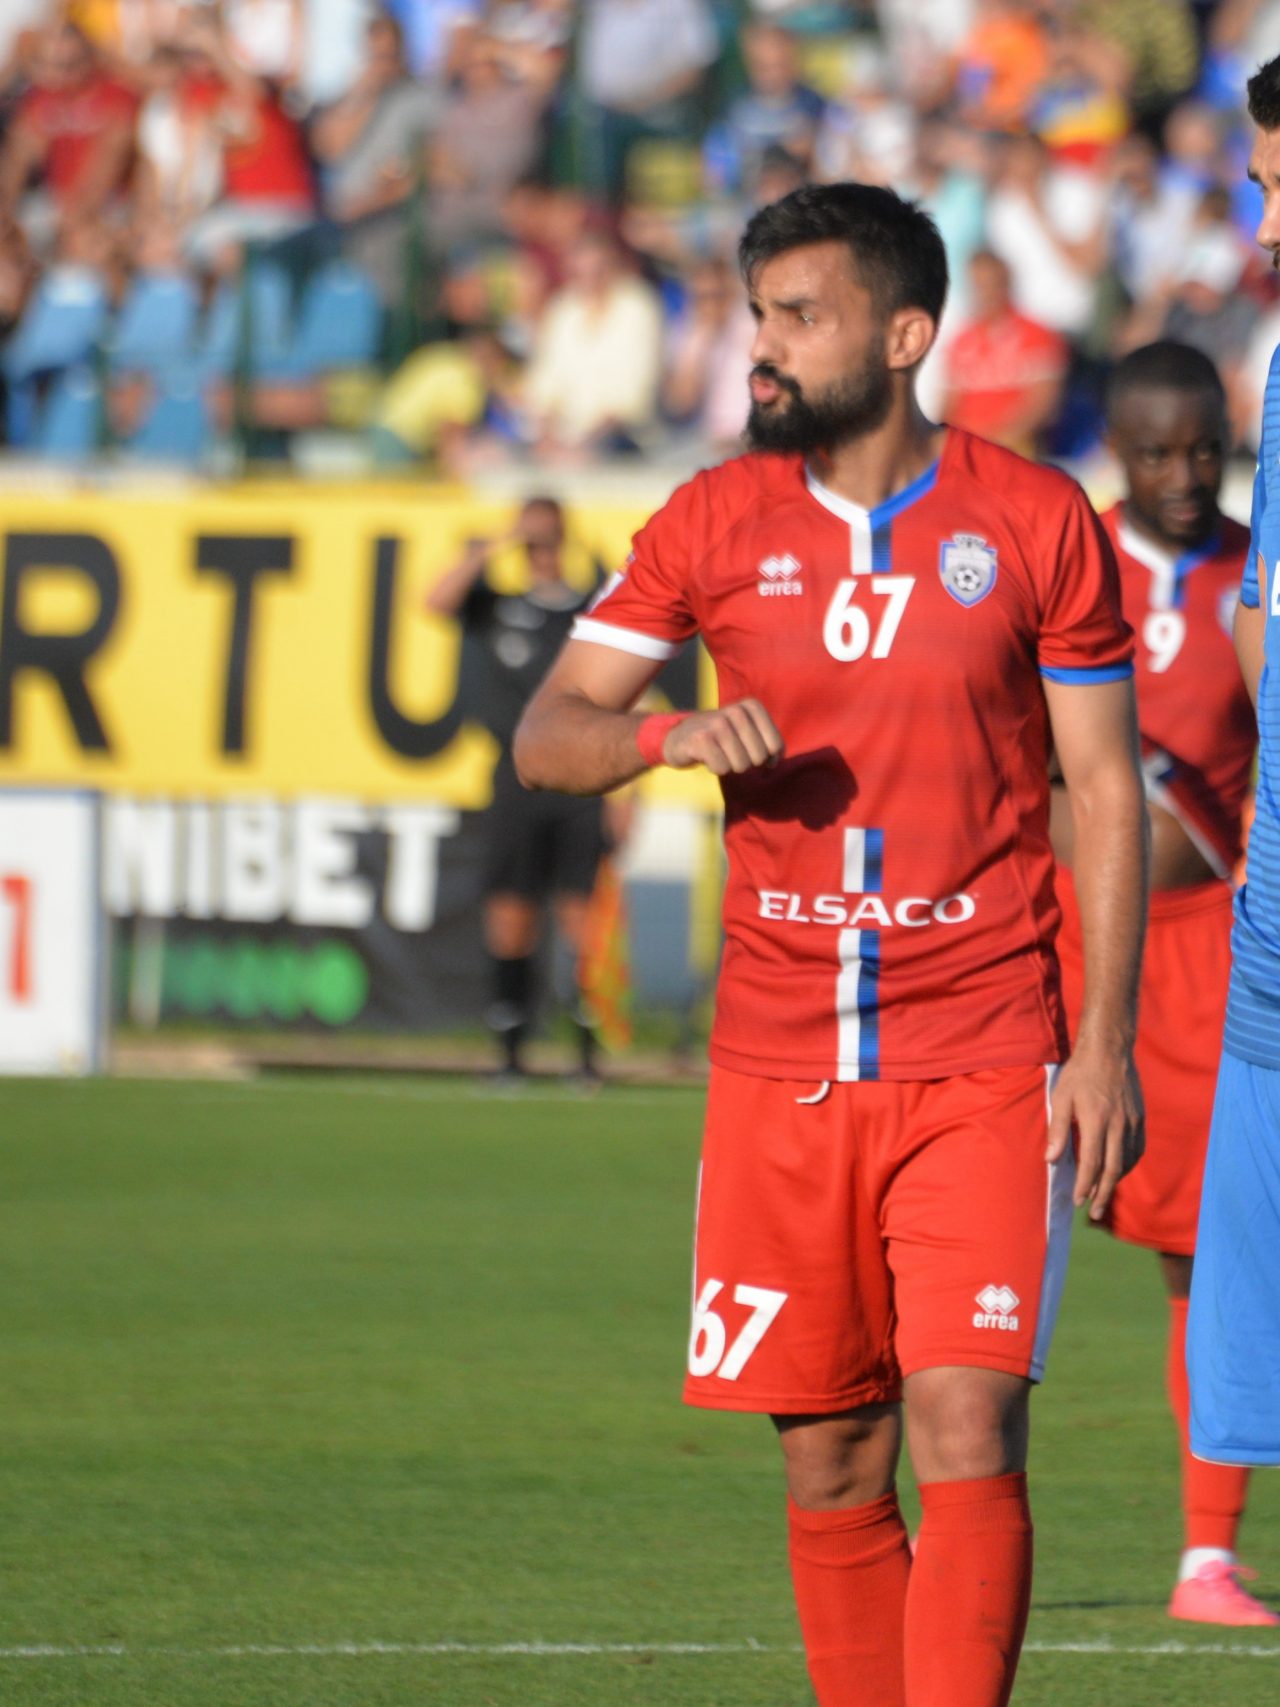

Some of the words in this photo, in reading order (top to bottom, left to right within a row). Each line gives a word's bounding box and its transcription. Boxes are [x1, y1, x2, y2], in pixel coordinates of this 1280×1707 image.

[822, 574, 916, 662] 67
[1145, 611, 1186, 673] 9
[758, 890, 976, 927] ELSACO
[688, 1277, 788, 1382] 67
[972, 1312, 1019, 1332] errea
